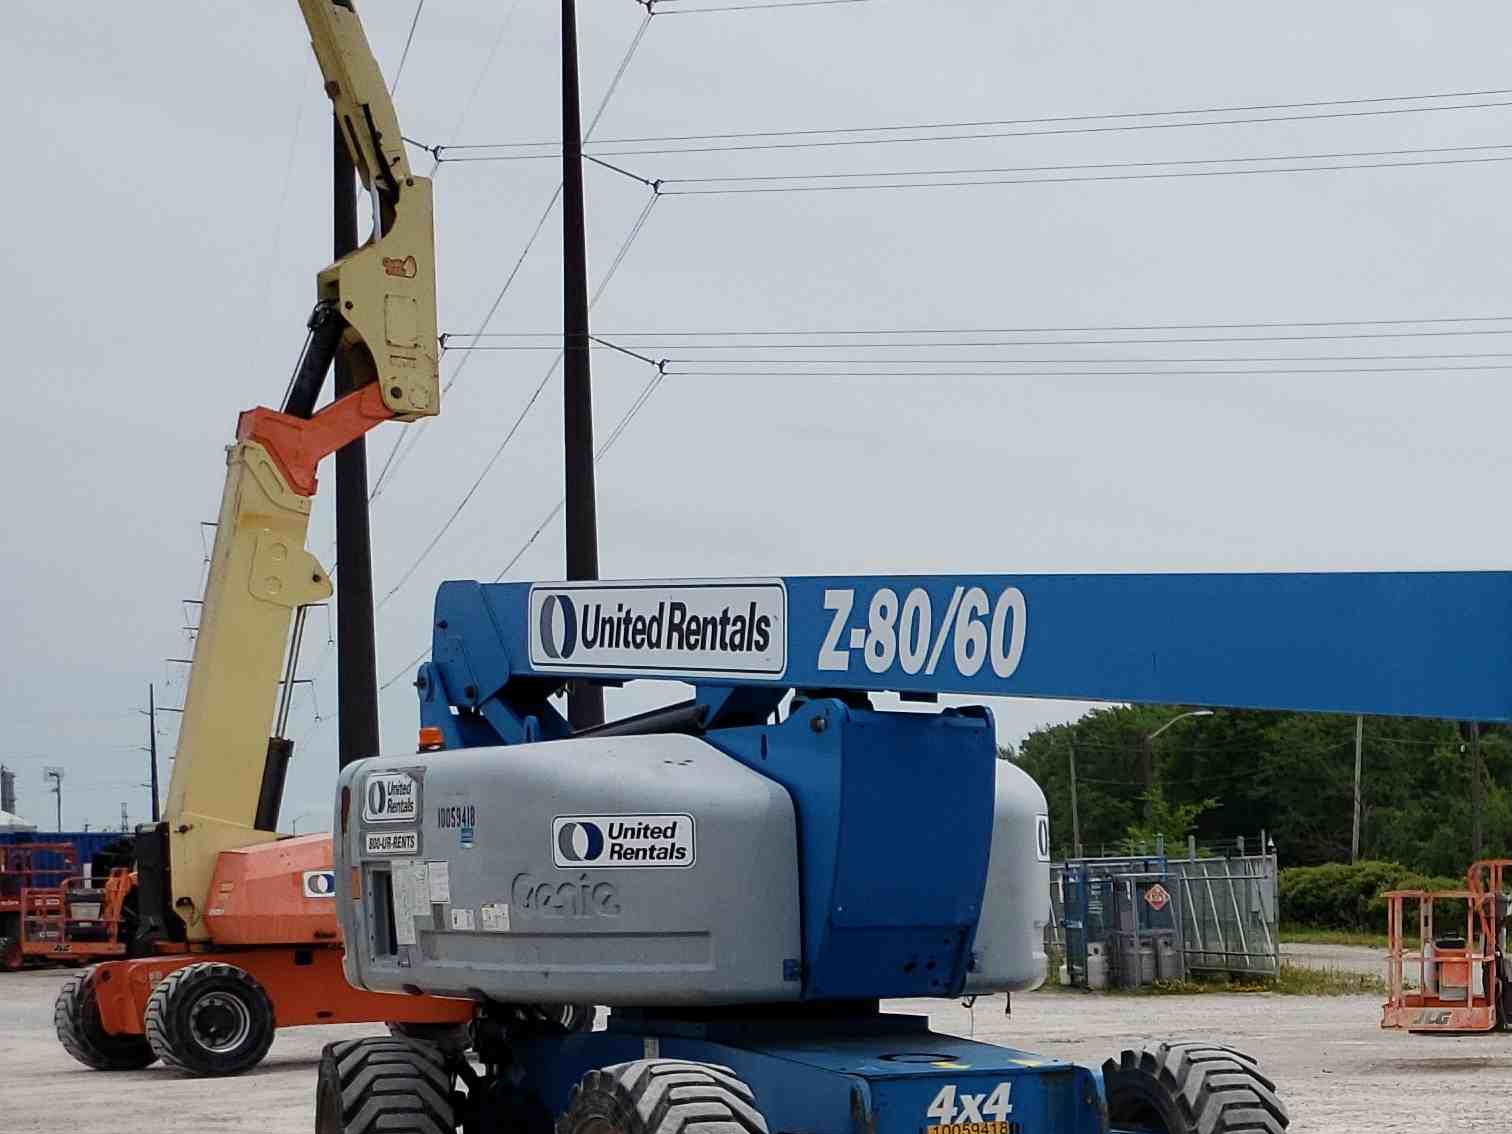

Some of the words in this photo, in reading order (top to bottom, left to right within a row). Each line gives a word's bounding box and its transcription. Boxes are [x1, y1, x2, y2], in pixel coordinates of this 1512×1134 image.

[581, 601, 664, 651] United
[666, 600, 771, 653] Rentals
[817, 586, 1027, 678] Z-80/60
[387, 780, 412, 796] United
[386, 798, 414, 814] Rentals
[608, 821, 678, 840] United
[609, 843, 688, 861] Rentals
[927, 1082, 1013, 1126] 4x4
